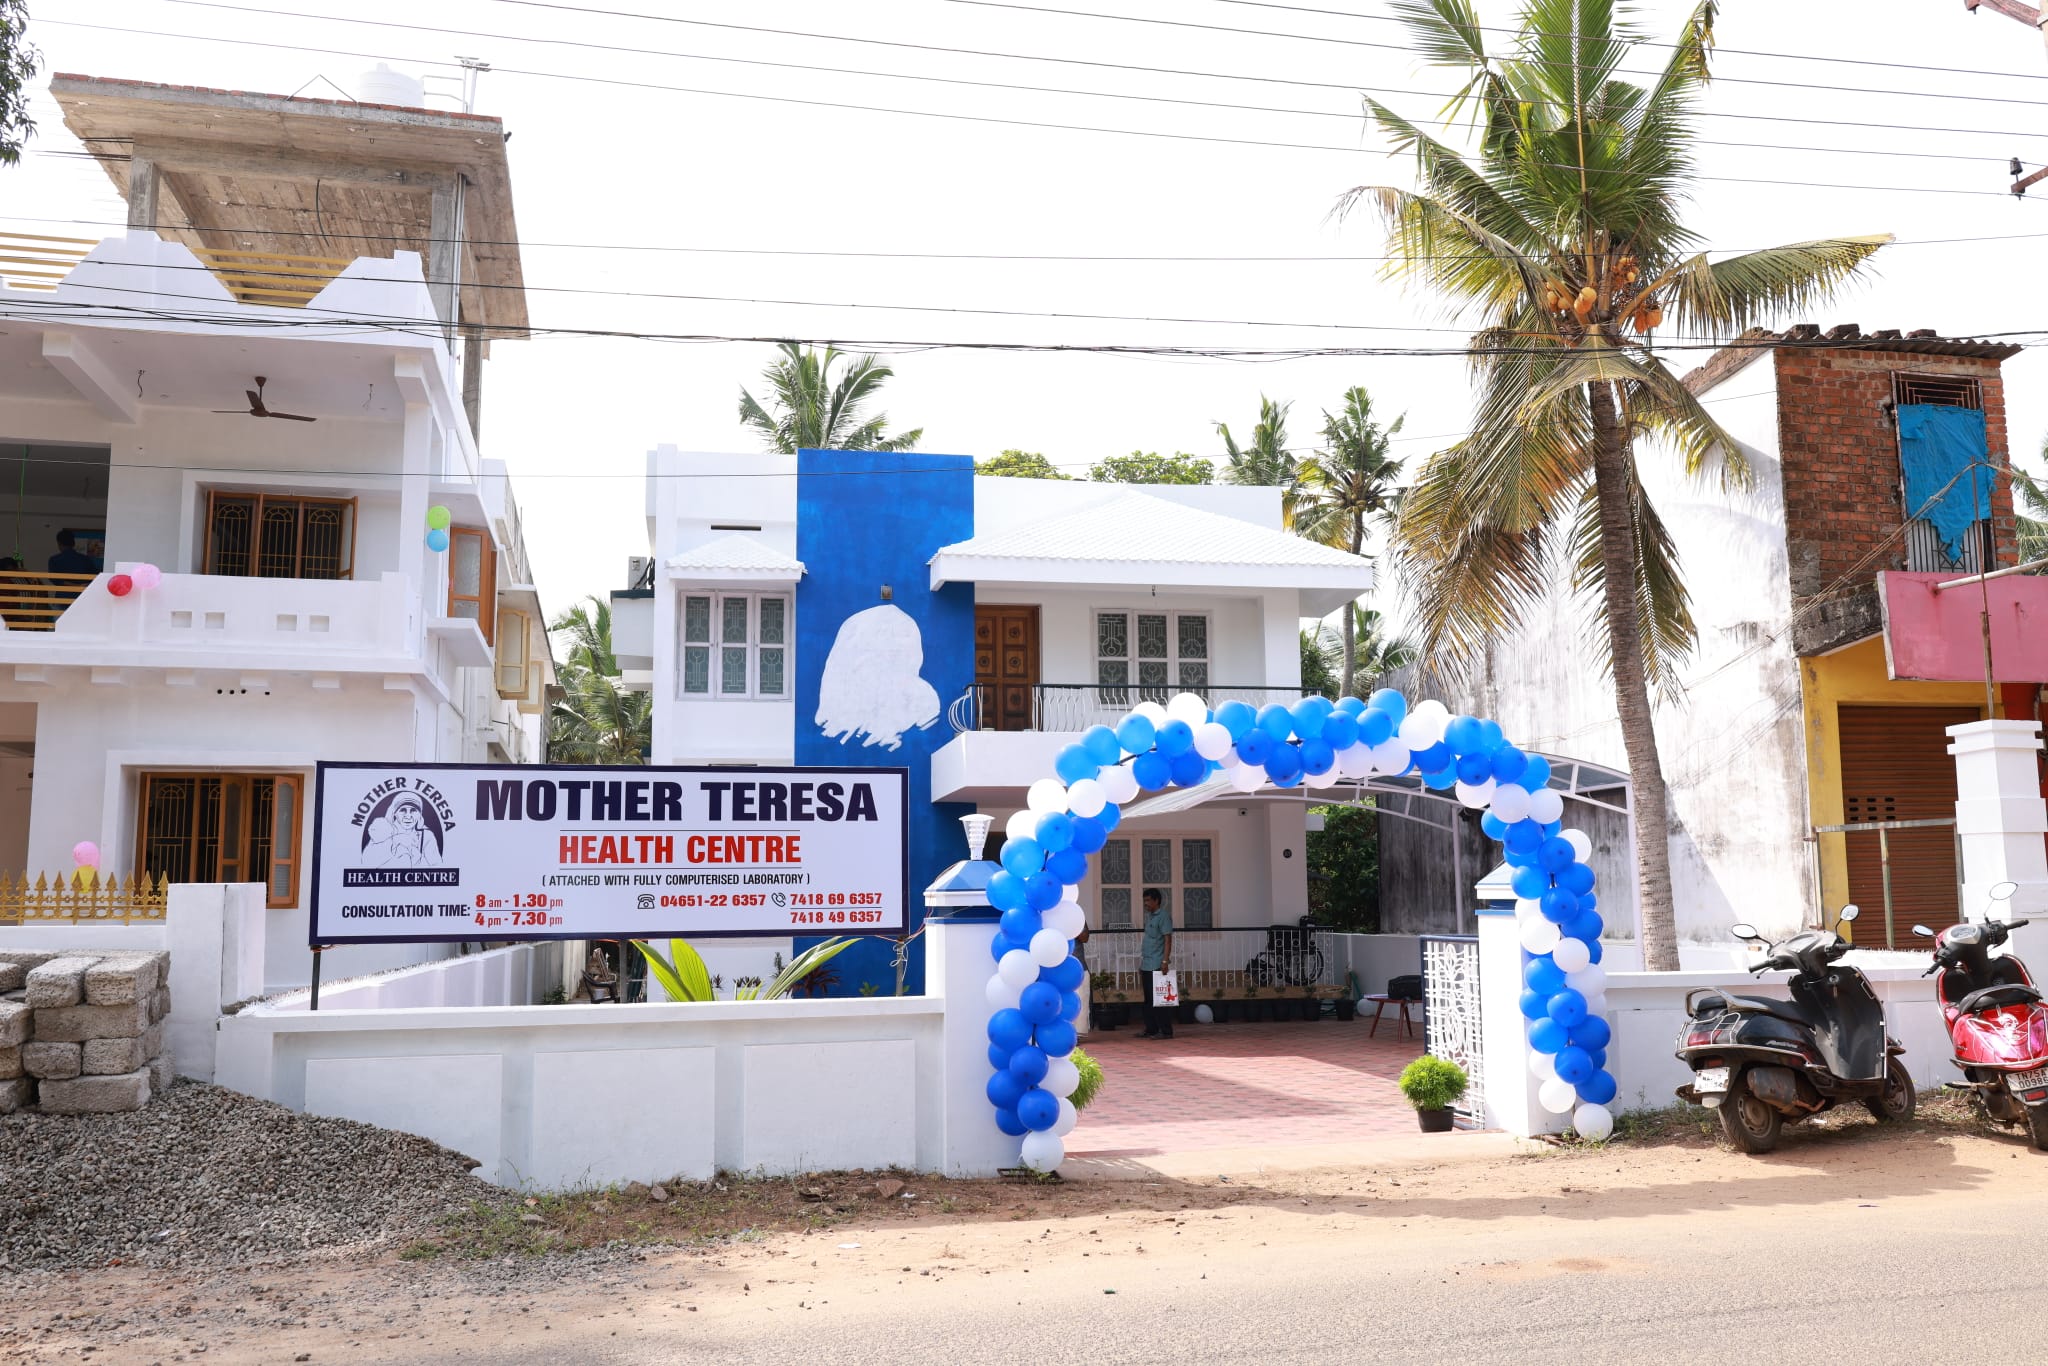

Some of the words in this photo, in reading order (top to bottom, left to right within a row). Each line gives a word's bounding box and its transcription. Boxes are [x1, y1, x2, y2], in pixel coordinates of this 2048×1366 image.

[351, 777, 407, 827] MOTHER
[414, 778, 456, 832] TERESA
[475, 779, 683, 821] MOTHER
[700, 781, 879, 822] TERESA
[559, 835, 674, 864] HEALTH
[687, 835, 802, 863] CENTRE
[347, 872, 401, 883] HEALTH
[404, 872, 457, 883] CENTRE
[604, 875, 630, 886] WITH
[633, 874, 662, 886] FULLY
[665, 873, 739, 885] COMPUTERISED
[475, 894, 486, 908] 8
[488, 899, 502, 908] am
[512, 894, 548, 907] 1.30
[550, 898, 564, 908] pm
[660, 894, 727, 907] 04651-22
[732, 894, 766, 906] 6357
[790, 893, 824, 905] 7418
[828, 893, 845, 905] 69
[849, 892, 883, 905] 6357
[341, 905, 433, 918] CONSULTATION
[437, 904, 471, 917] TIME:
[790, 911, 824, 923] 7418
[828, 911, 845, 923] 49
[849, 910, 883, 923] 6357
[474, 912, 485, 926] 4
[487, 918, 502, 928] pm
[511, 911, 547, 926] 7.30
[549, 917, 563, 927] pm
